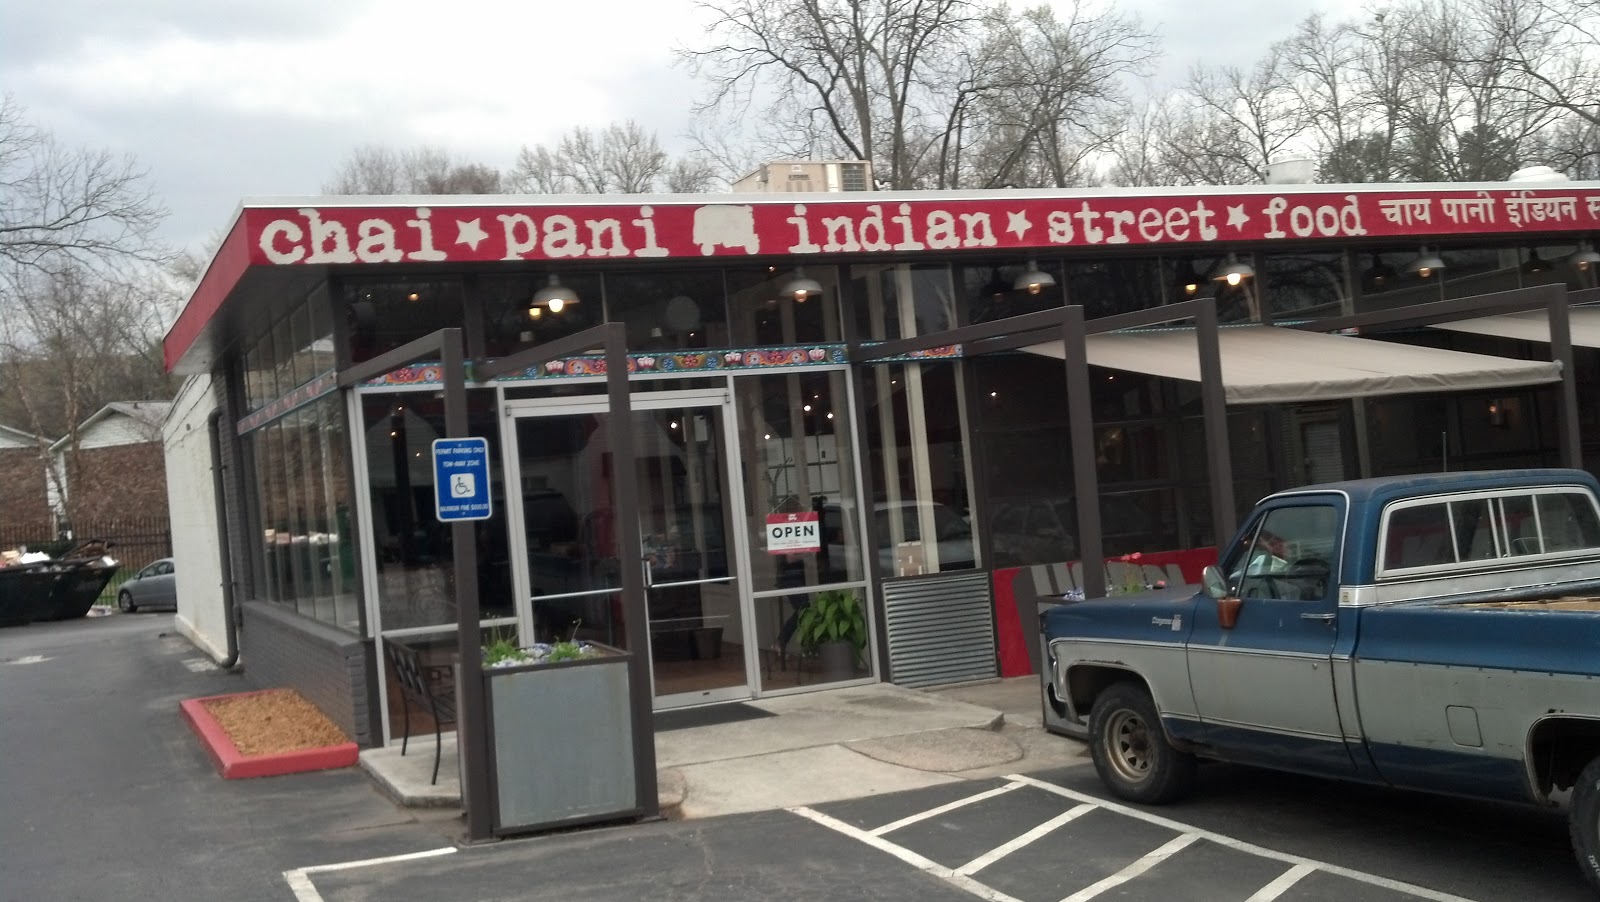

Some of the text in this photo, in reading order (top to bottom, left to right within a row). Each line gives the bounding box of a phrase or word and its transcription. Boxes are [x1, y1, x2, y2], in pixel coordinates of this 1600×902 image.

[1378, 198, 1432, 226] चाय
[1441, 190, 1496, 224] पानी
[258, 194, 1368, 265] chai pani indian street food
[772, 525, 814, 539] OPEN
